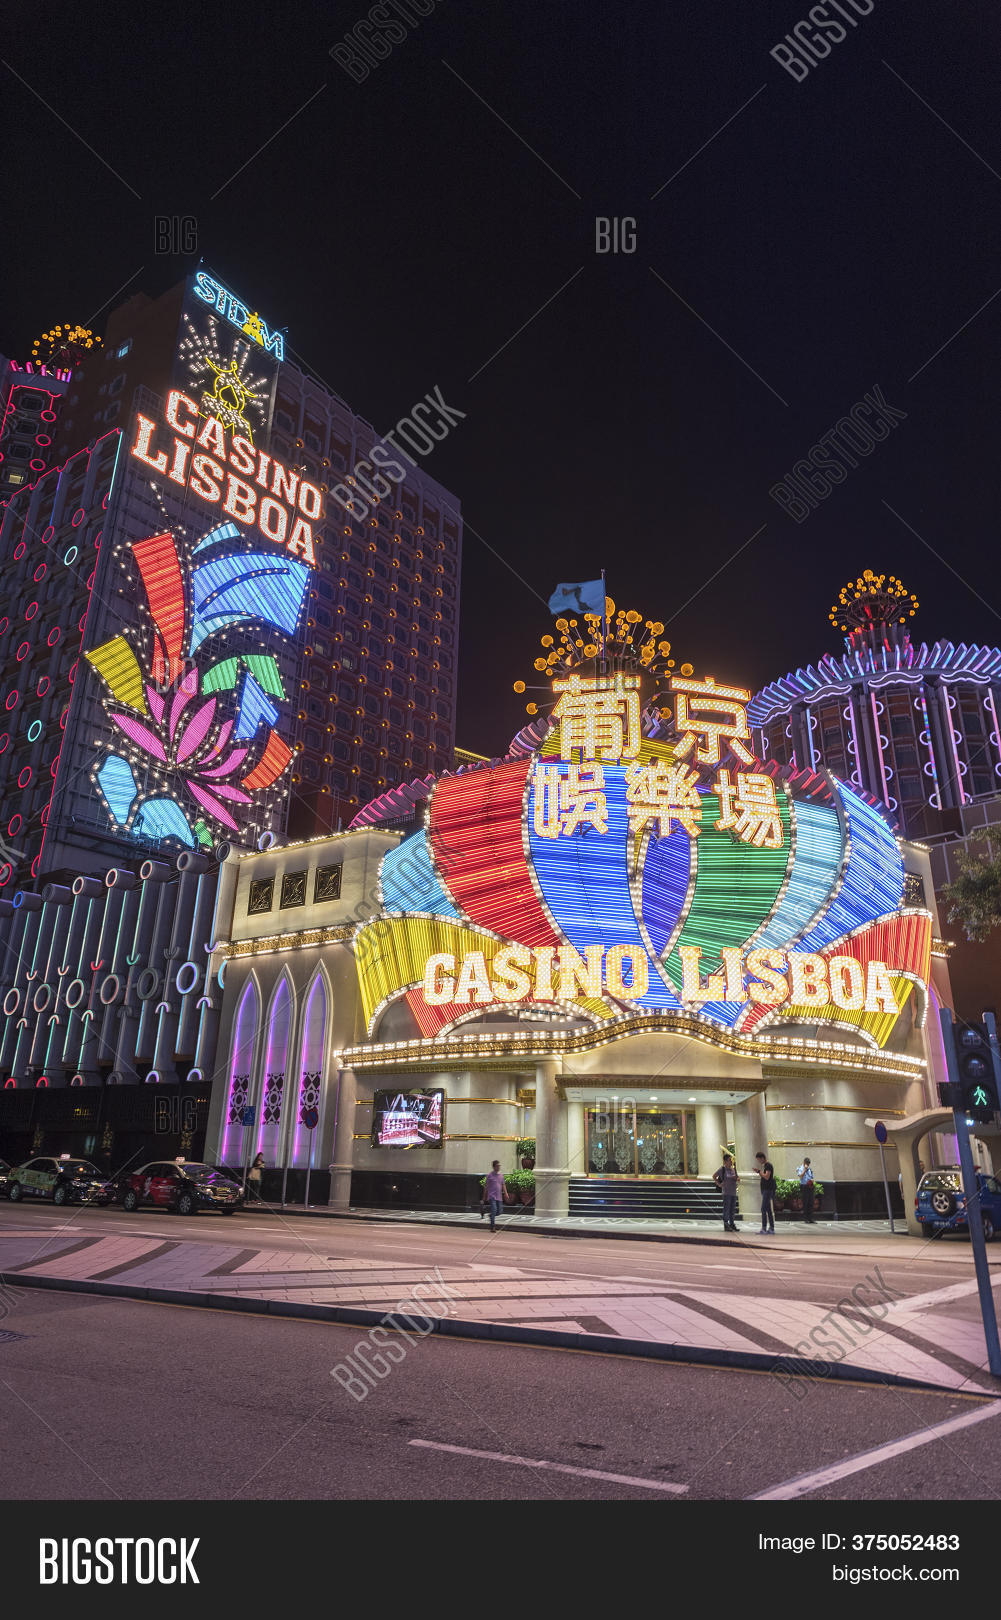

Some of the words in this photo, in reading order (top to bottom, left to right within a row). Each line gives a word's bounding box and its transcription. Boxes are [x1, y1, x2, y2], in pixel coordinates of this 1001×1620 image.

[130, 413, 317, 565] LISBOA
[165, 389, 322, 522] CASINO
[551, 671, 756, 766] 葡京
[422, 943, 651, 1007] CASINO
[676, 944, 902, 1015] LISBOA
